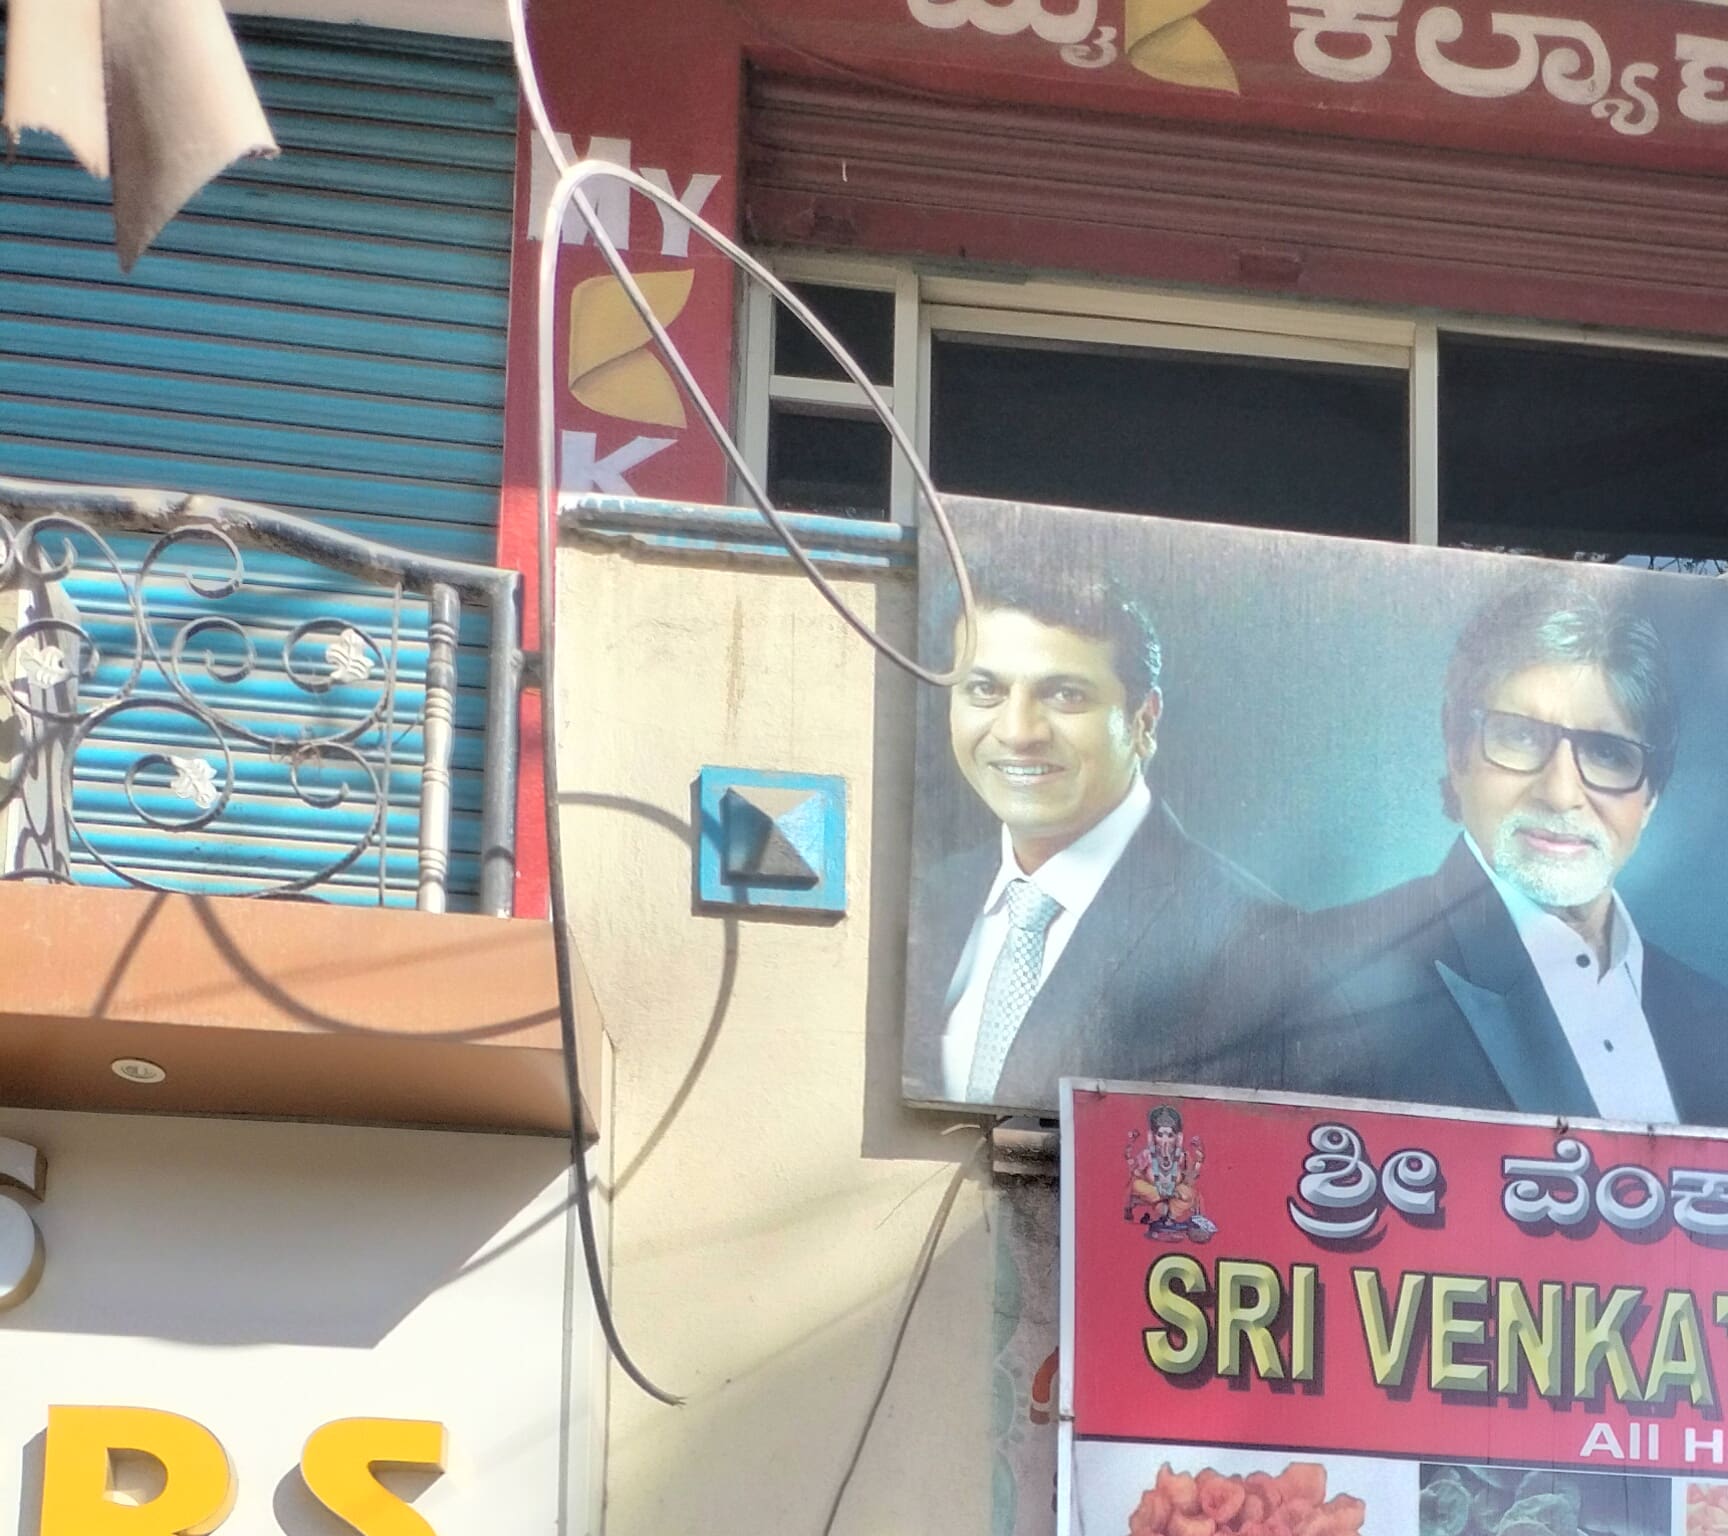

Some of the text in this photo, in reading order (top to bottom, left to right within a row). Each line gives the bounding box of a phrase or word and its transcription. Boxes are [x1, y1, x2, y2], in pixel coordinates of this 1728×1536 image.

[526, 129, 722, 258] MY
[1290, 1121, 1441, 1239] ಶ್ರೀ
[1142, 1253, 1320, 1384] SRI
[1579, 1422, 1660, 1461] All
